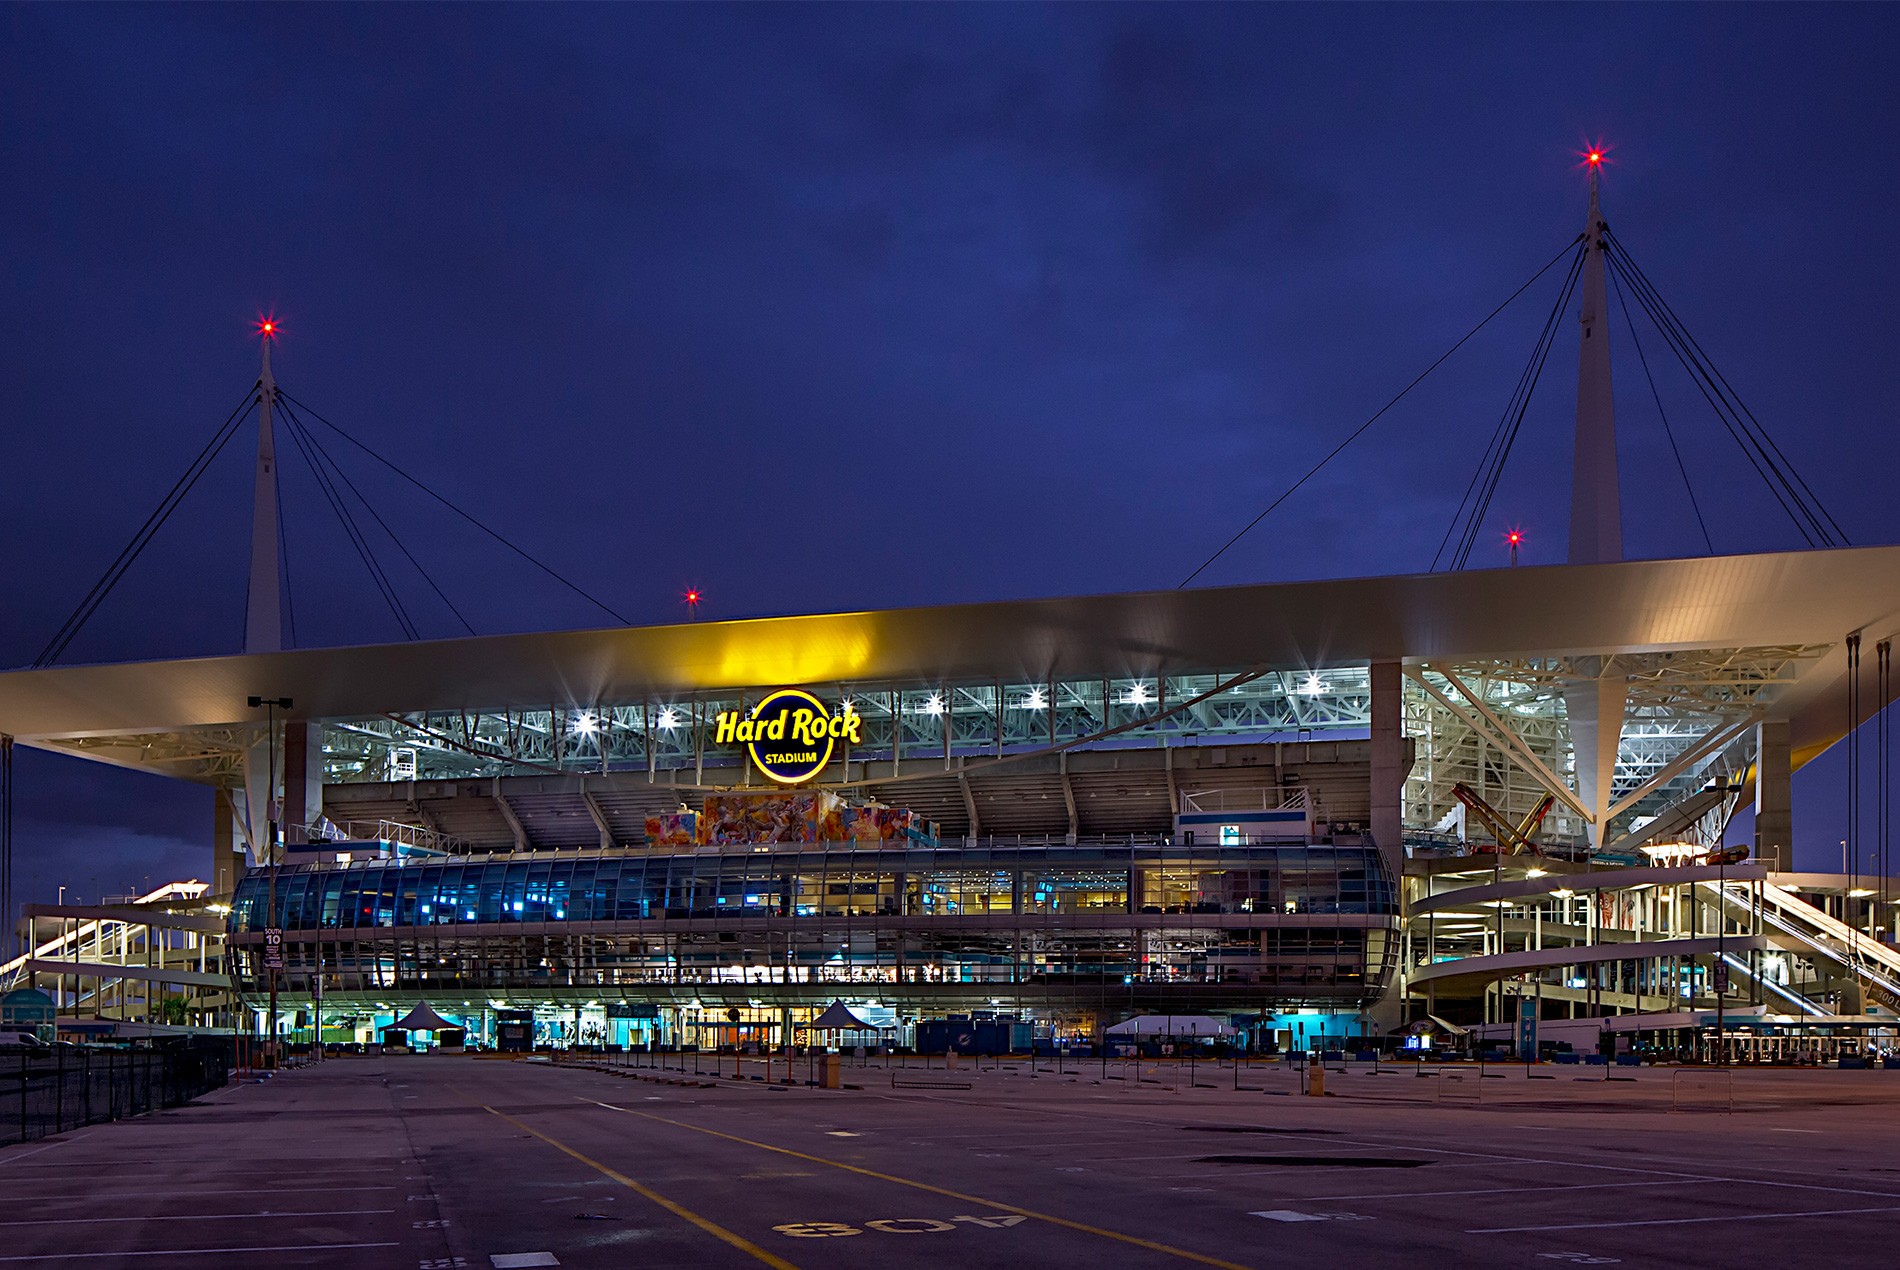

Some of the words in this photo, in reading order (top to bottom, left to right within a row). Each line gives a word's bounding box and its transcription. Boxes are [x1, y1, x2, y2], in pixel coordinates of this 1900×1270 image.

[715, 708, 790, 744] Hard
[792, 705, 862, 746] Rock
[765, 752, 817, 765] STADIUM
[265, 935, 281, 945] 10
[1716, 966, 1727, 974] 11
[1876, 990, 1895, 1005] 300
